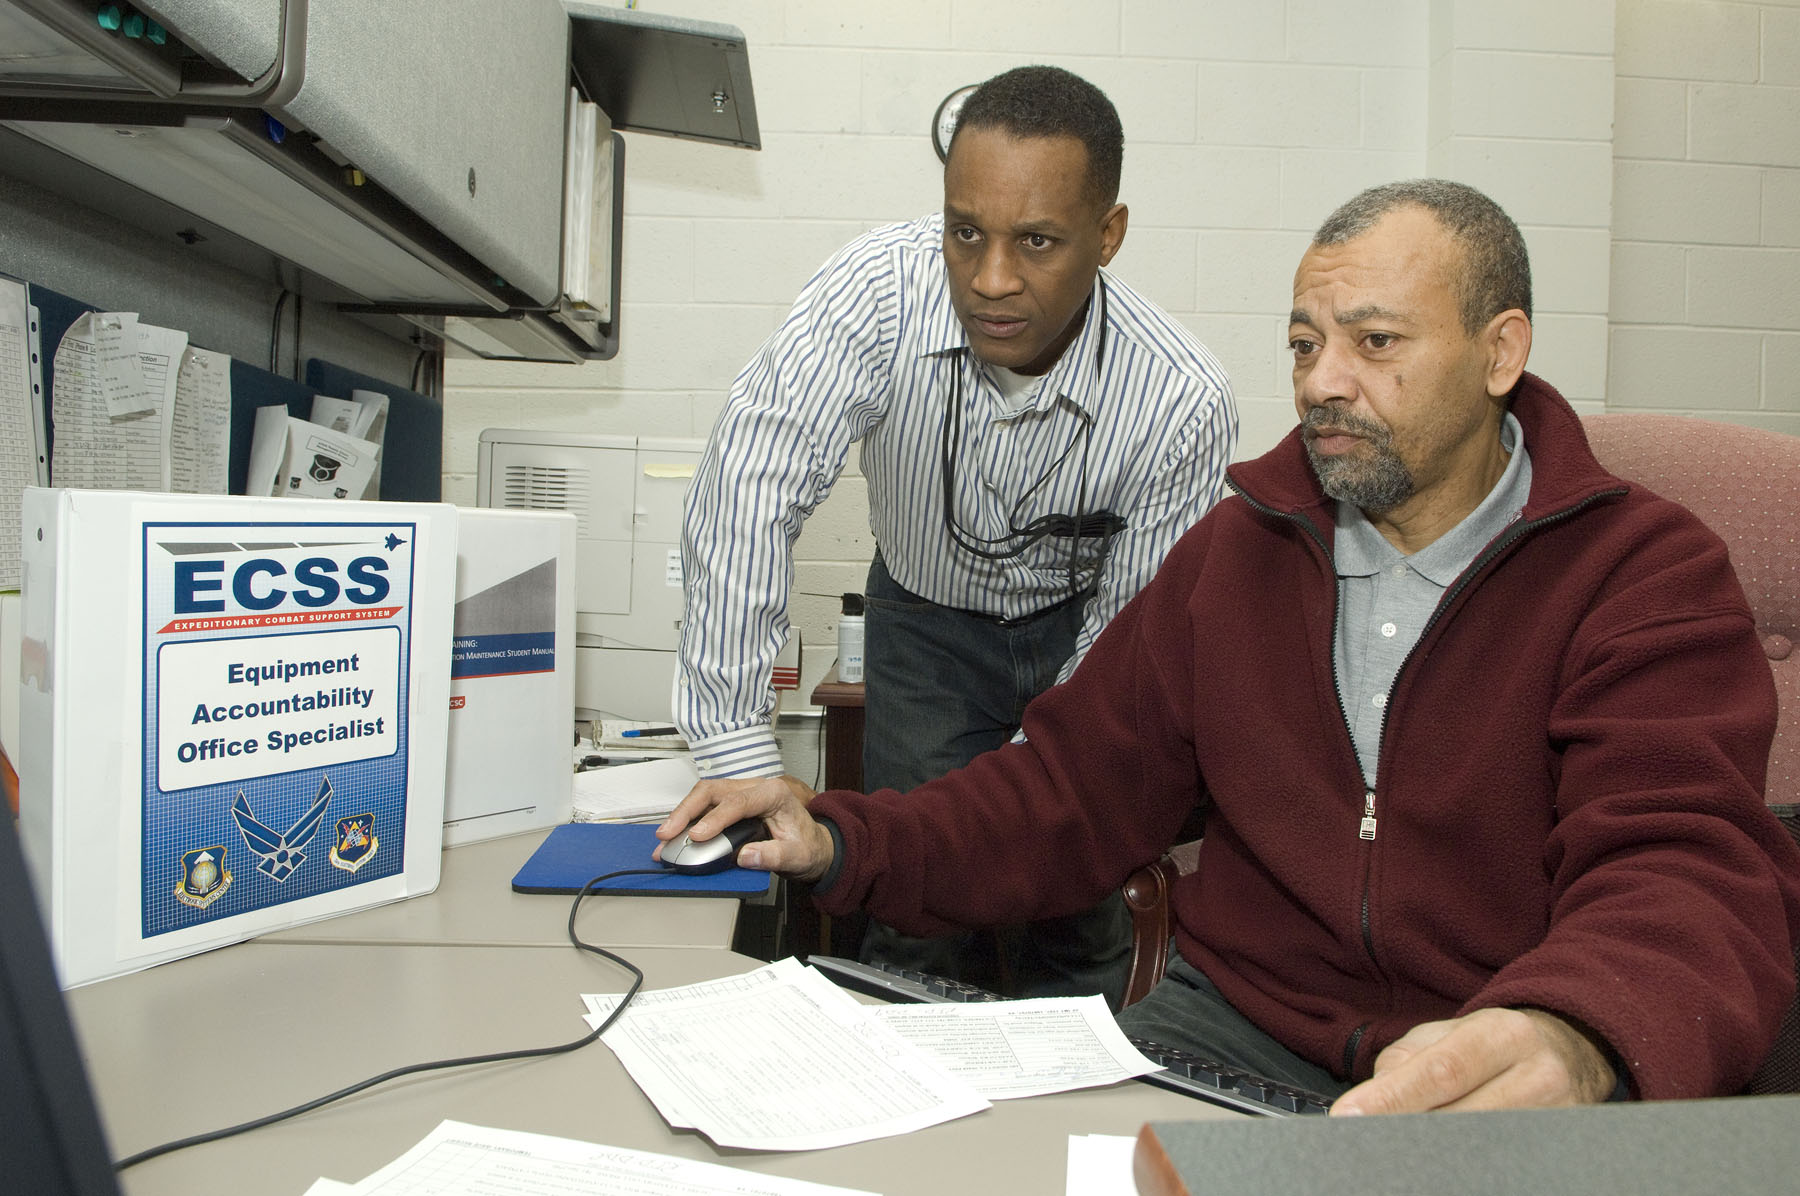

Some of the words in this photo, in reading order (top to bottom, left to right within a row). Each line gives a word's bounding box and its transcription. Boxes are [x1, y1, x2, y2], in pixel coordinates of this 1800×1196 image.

[174, 556, 390, 614] ECSS
[174, 618, 261, 630] EXPEDITIONARY
[265, 615, 305, 624] COMBAT
[309, 613, 352, 621] SUPPORT
[355, 610, 390, 618] SYSTEM
[452, 653, 465, 661] TION
[453, 640, 478, 648] AINING:
[228, 653, 359, 686] Equipment
[191, 687, 374, 725] Accountability
[177, 738, 259, 763] Office
[267, 717, 384, 753] Specialist
